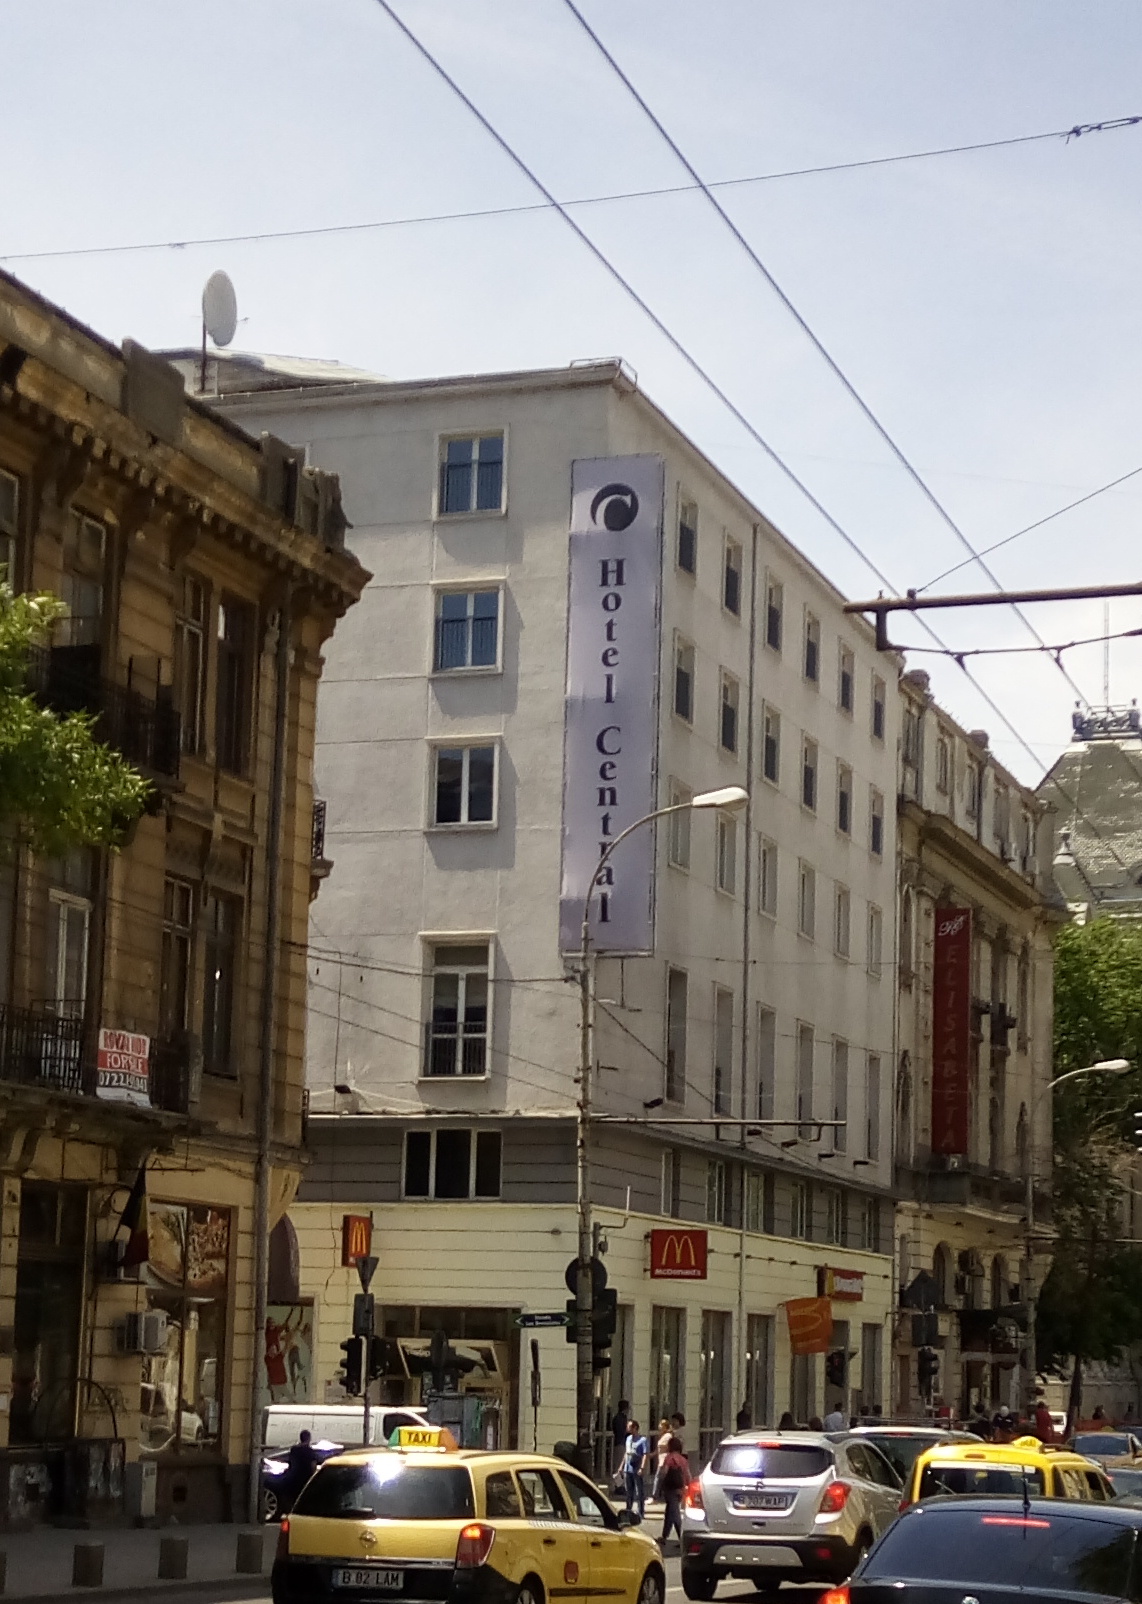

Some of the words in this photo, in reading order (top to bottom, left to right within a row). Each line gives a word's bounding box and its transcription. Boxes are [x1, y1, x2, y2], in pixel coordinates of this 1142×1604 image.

[598, 558, 626, 705] Hotel
[595, 725, 622, 923] Central
[107, 1053, 128, 1069] FOR
[127, 1056, 142, 1073] SLE
[407, 1431, 431, 1444] TAXI
[342, 1570, 351, 1584] B
[356, 1571, 370, 1585] 02
[376, 1571, 399, 1586] LAM
